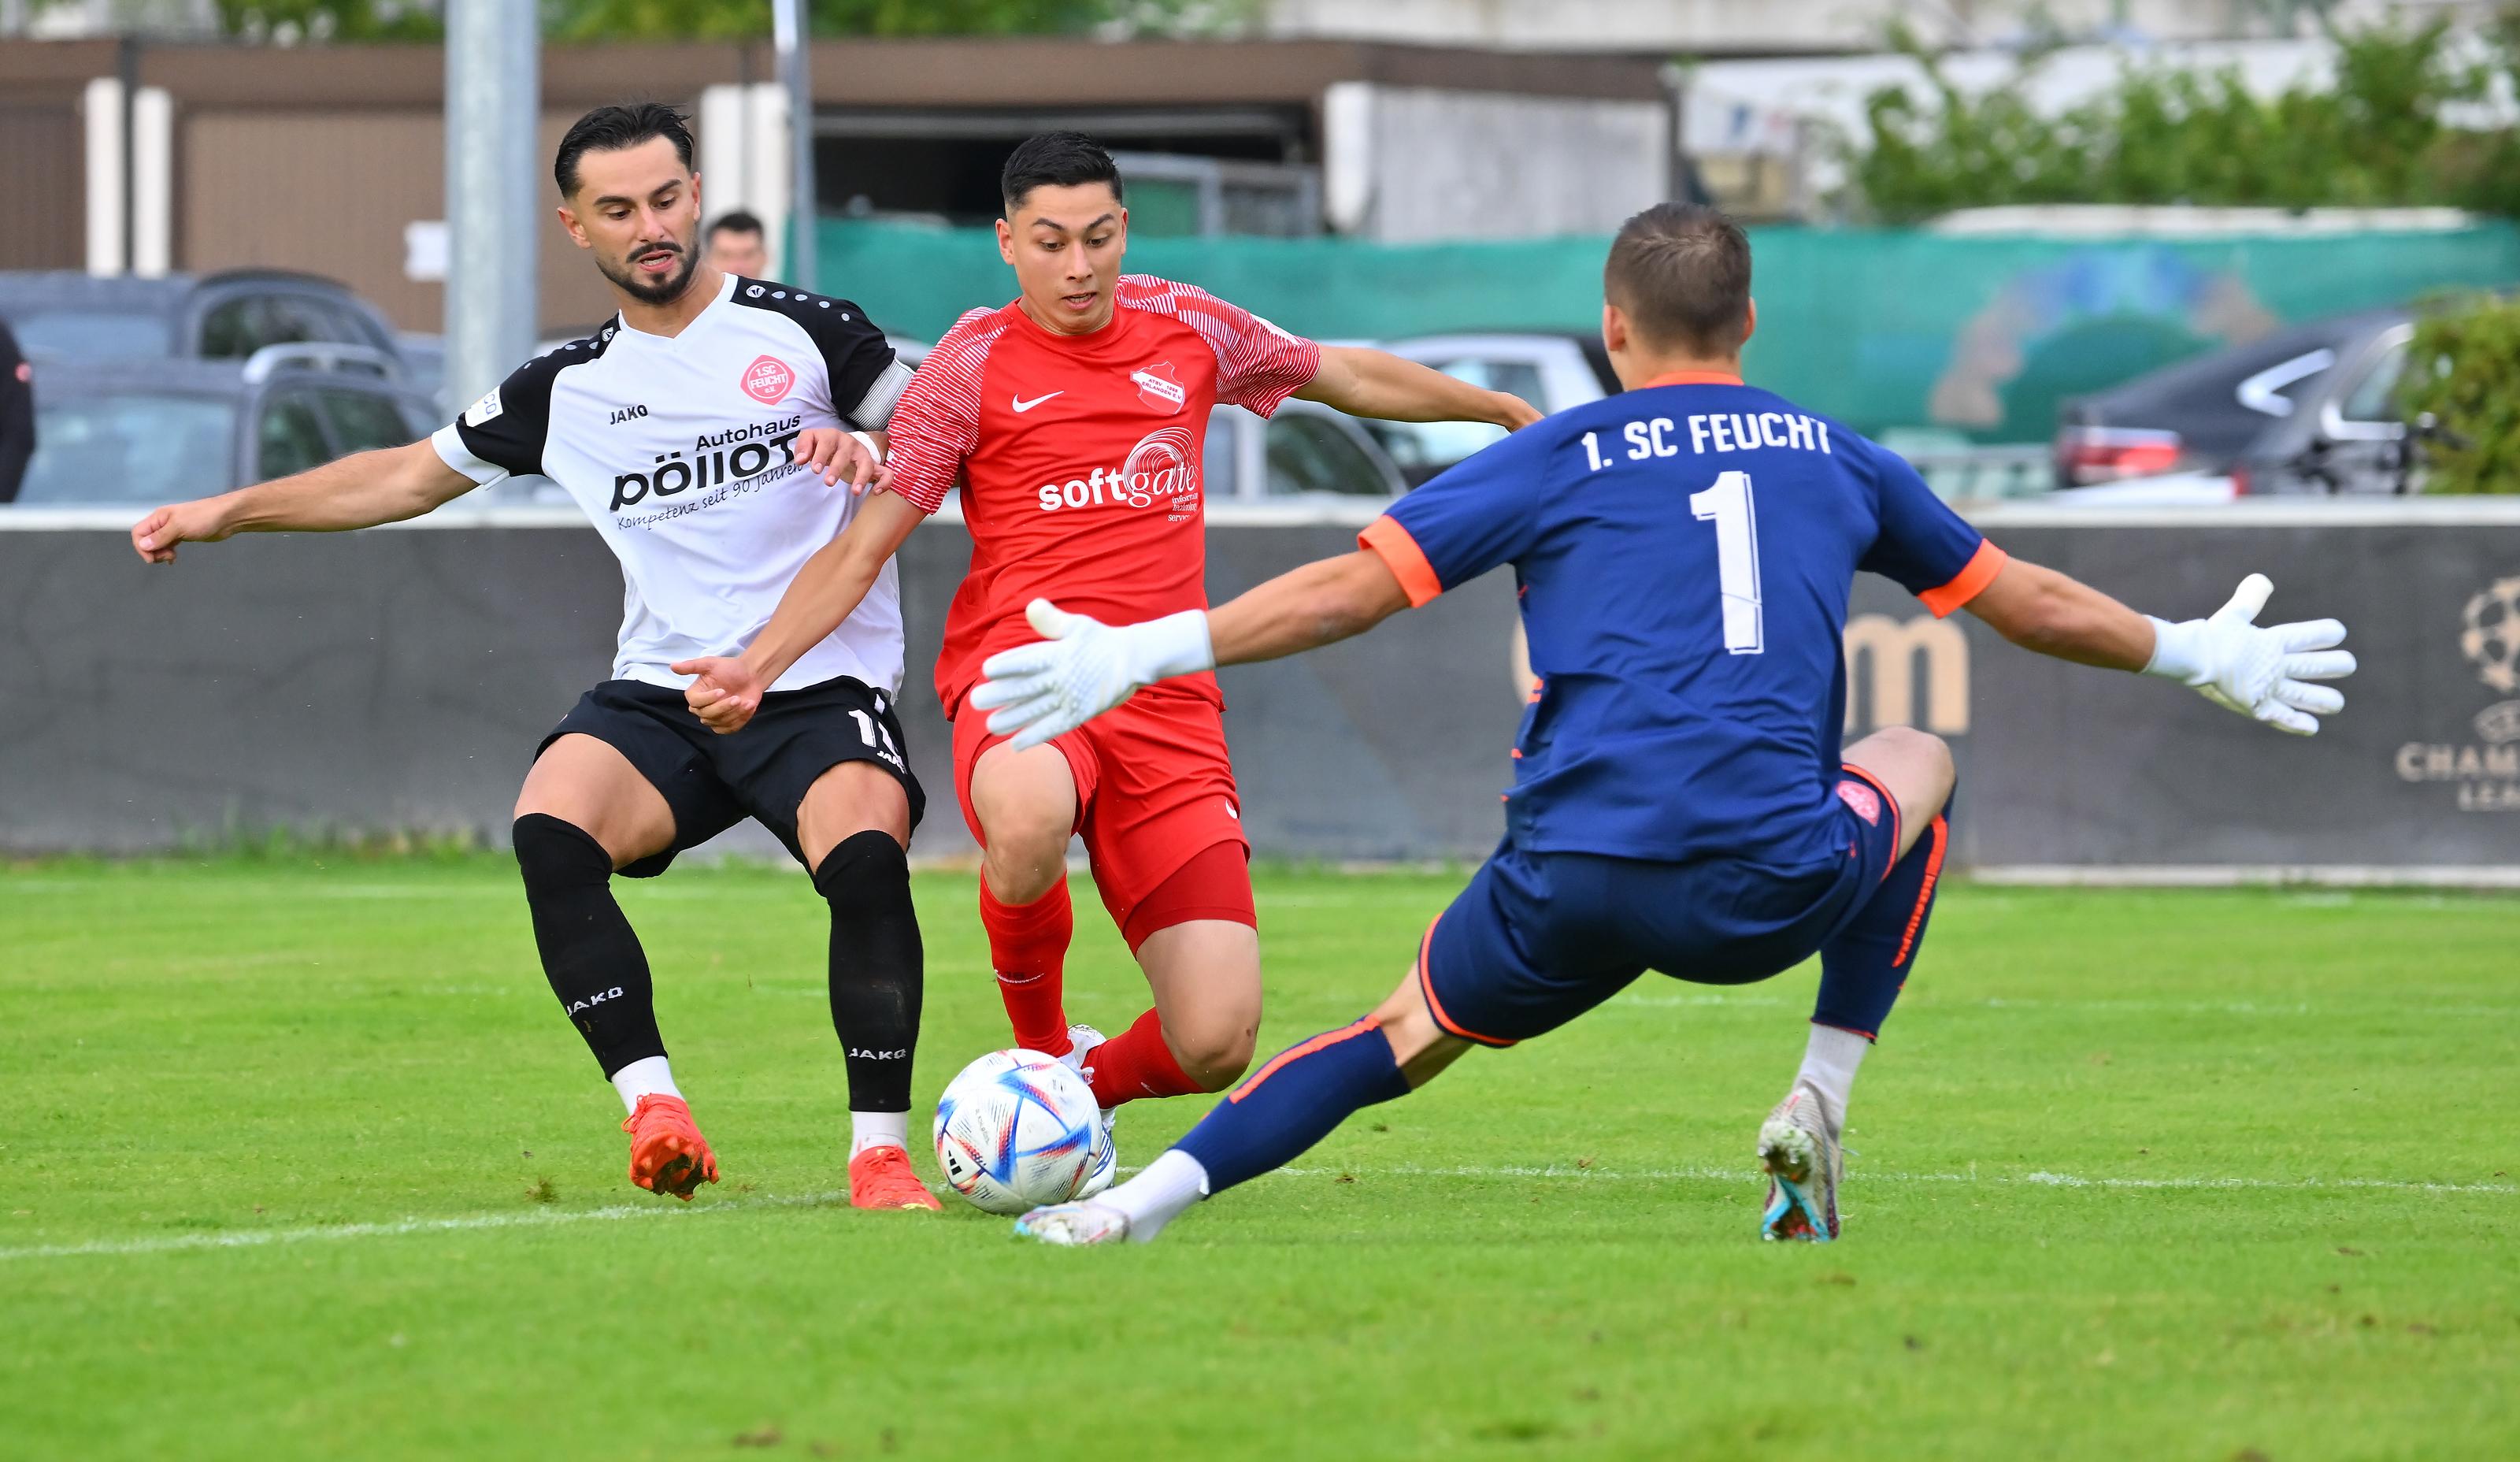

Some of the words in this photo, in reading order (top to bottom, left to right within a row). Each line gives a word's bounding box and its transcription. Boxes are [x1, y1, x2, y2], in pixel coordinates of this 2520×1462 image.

[750, 373, 787, 389] FEUCHT
[1142, 381, 1172, 396] ERLANGEN
[610, 404, 648, 425] JAKO
[695, 415, 801, 451] Autohaus
[1581, 432, 1613, 471] 1.
[1624, 417, 1678, 460] SC
[1688, 412, 1831, 455] FEUCHT
[1039, 460, 1195, 511] softgate
[617, 503, 699, 530] Kompetenz
[702, 488, 728, 509] seit
[733, 480, 750, 498] 90
[1689, 471, 1765, 655] 1
[567, 987, 623, 1017] JAKO
[848, 1048, 906, 1060] JAKO
